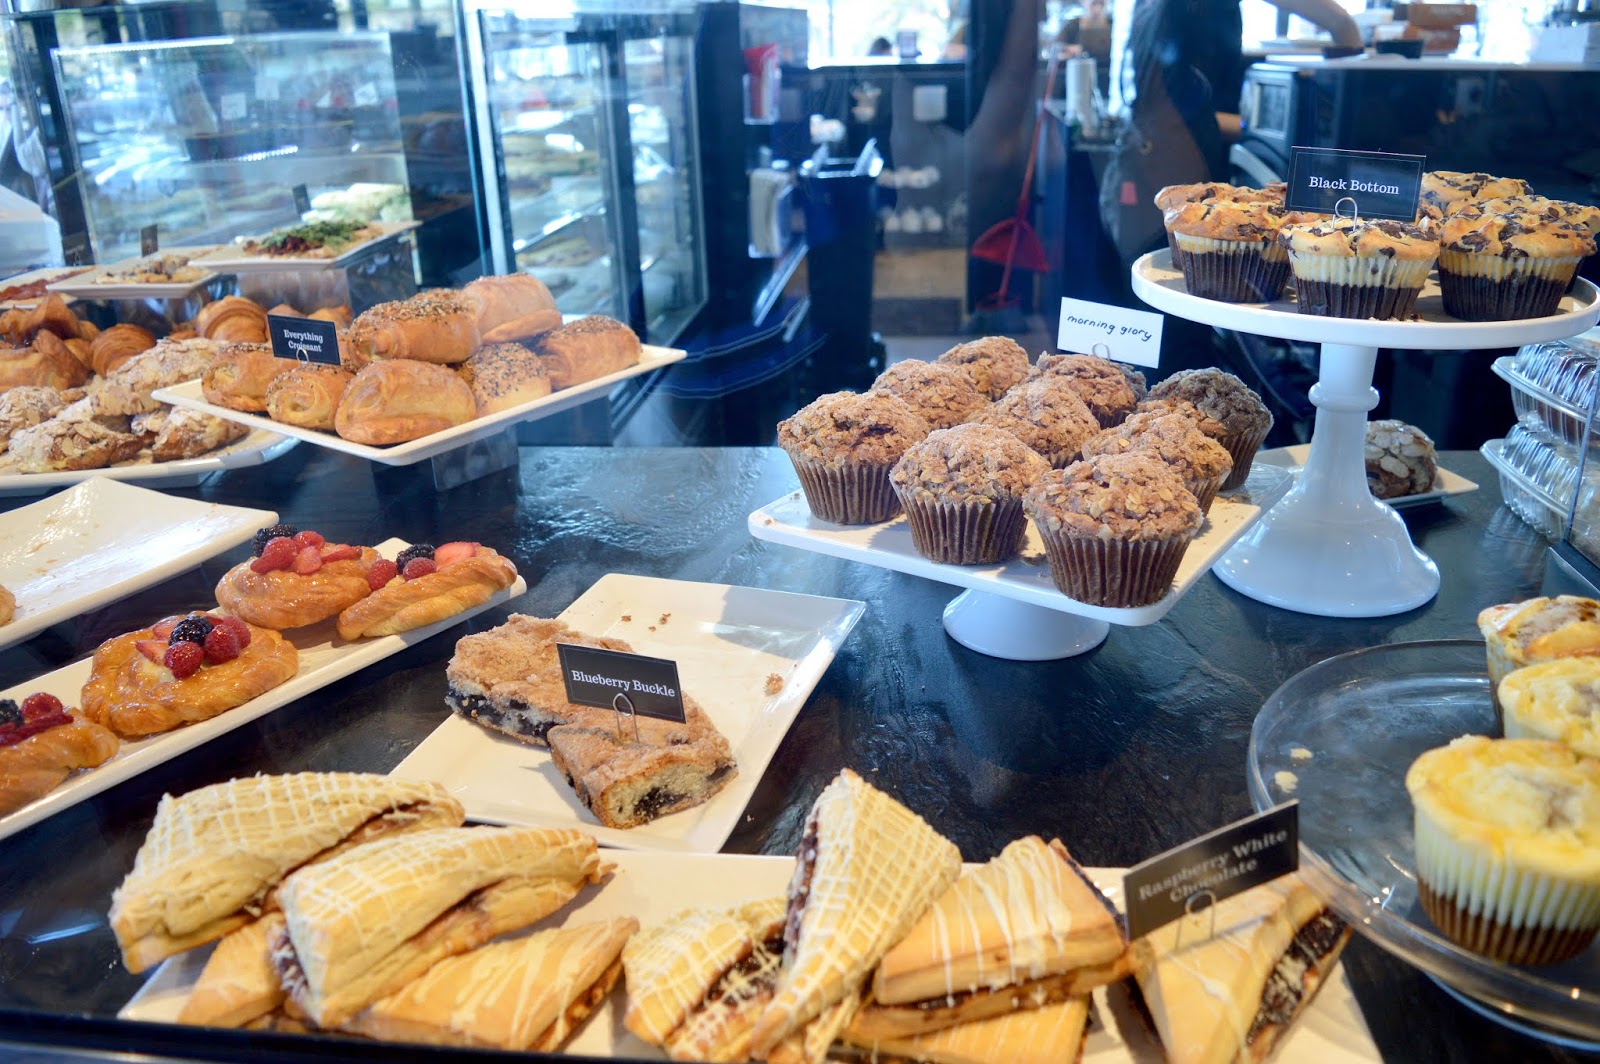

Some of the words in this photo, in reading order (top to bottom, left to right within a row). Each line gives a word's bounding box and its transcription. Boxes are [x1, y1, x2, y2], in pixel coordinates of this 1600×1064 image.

[1308, 176, 1347, 190] Black
[1349, 179, 1399, 195] Bottom
[283, 329, 324, 344] Everything
[1067, 315, 1116, 335] morning
[1120, 326, 1152, 342] glory
[288, 340, 322, 352] Croissant
[571, 670, 631, 692] Blueberry
[632, 679, 675, 697] Buckle
[1138, 852, 1229, 901] Raspberry
[1232, 829, 1288, 859] White
